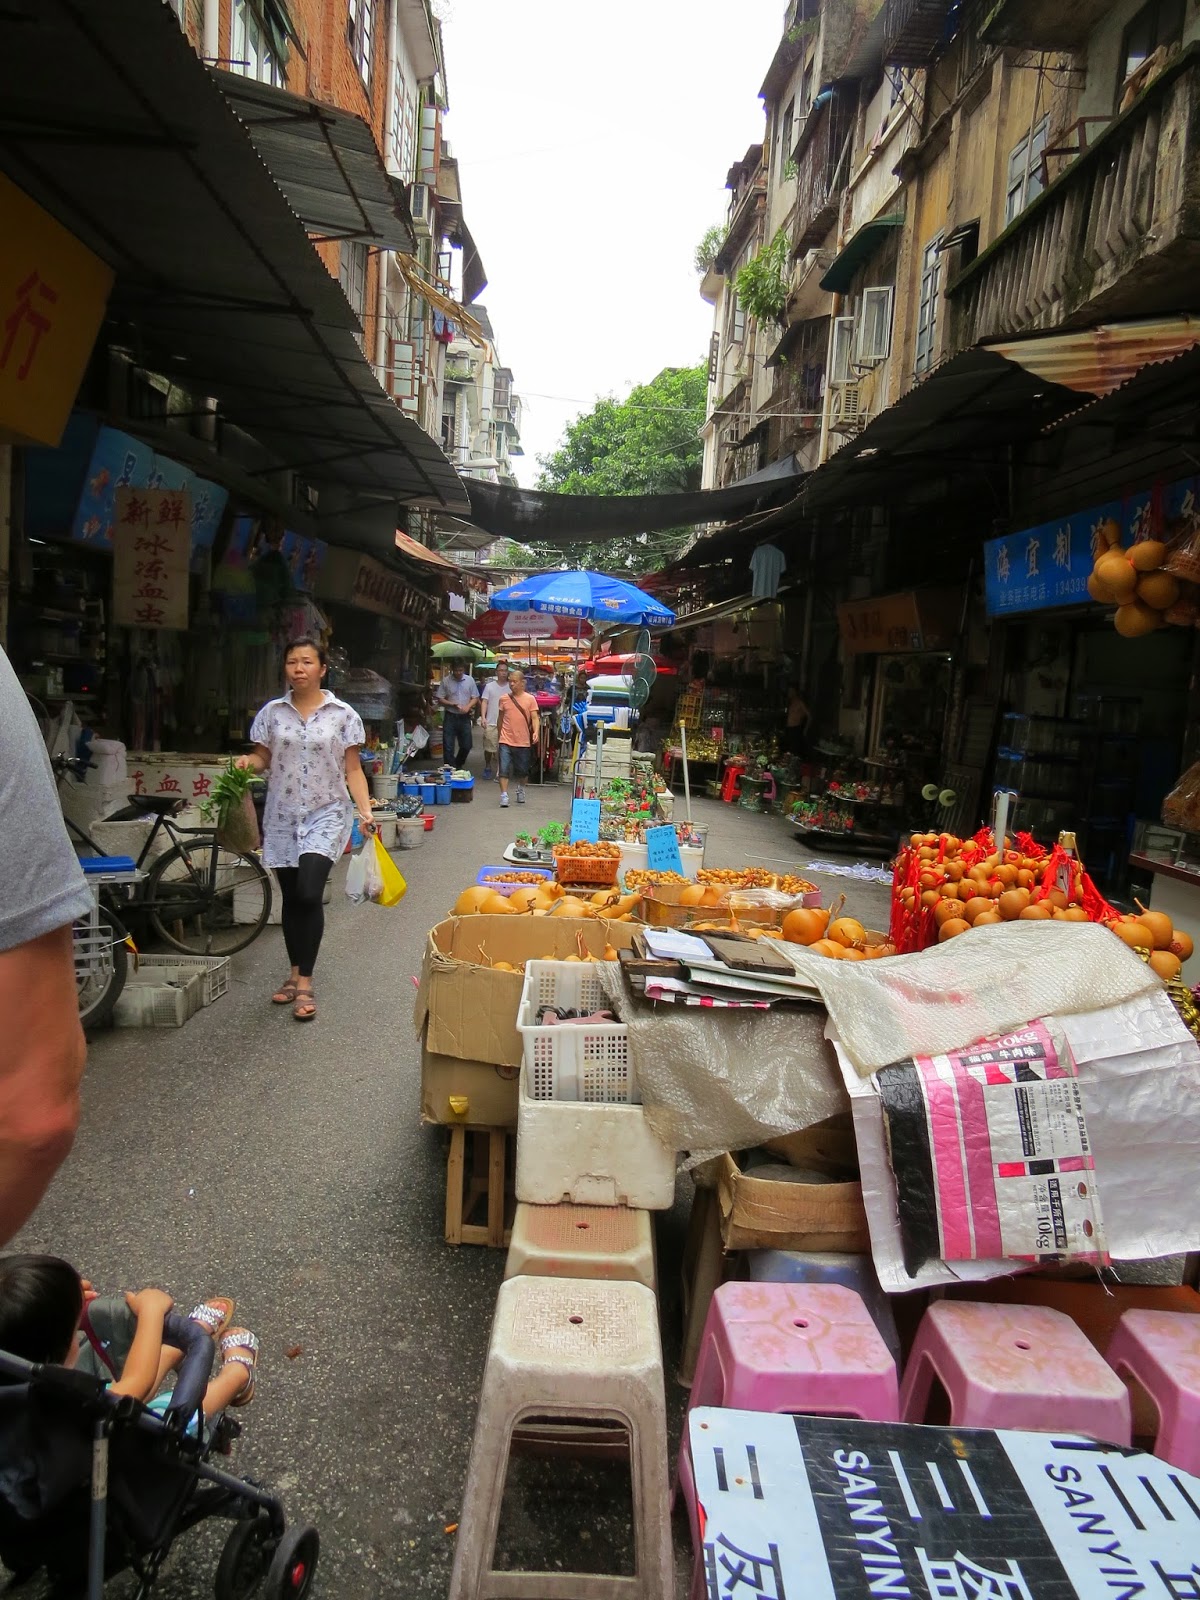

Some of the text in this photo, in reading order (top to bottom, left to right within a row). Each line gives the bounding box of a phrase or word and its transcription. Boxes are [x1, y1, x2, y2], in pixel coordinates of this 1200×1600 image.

[0, 270, 57, 381] 行
[120, 494, 186, 530] 新鲜
[132, 534, 174, 625] 冰冻血虫
[1055, 576, 1089, 596] 134339
[996, 1031, 1038, 1047] 10kg
[1000, 1046, 1037, 1059] 牛肉味
[1036, 1215, 1053, 1248] 10kg
[833, 1448, 914, 1600] SANYIN
[1097, 1464, 1200, 1600] 三
